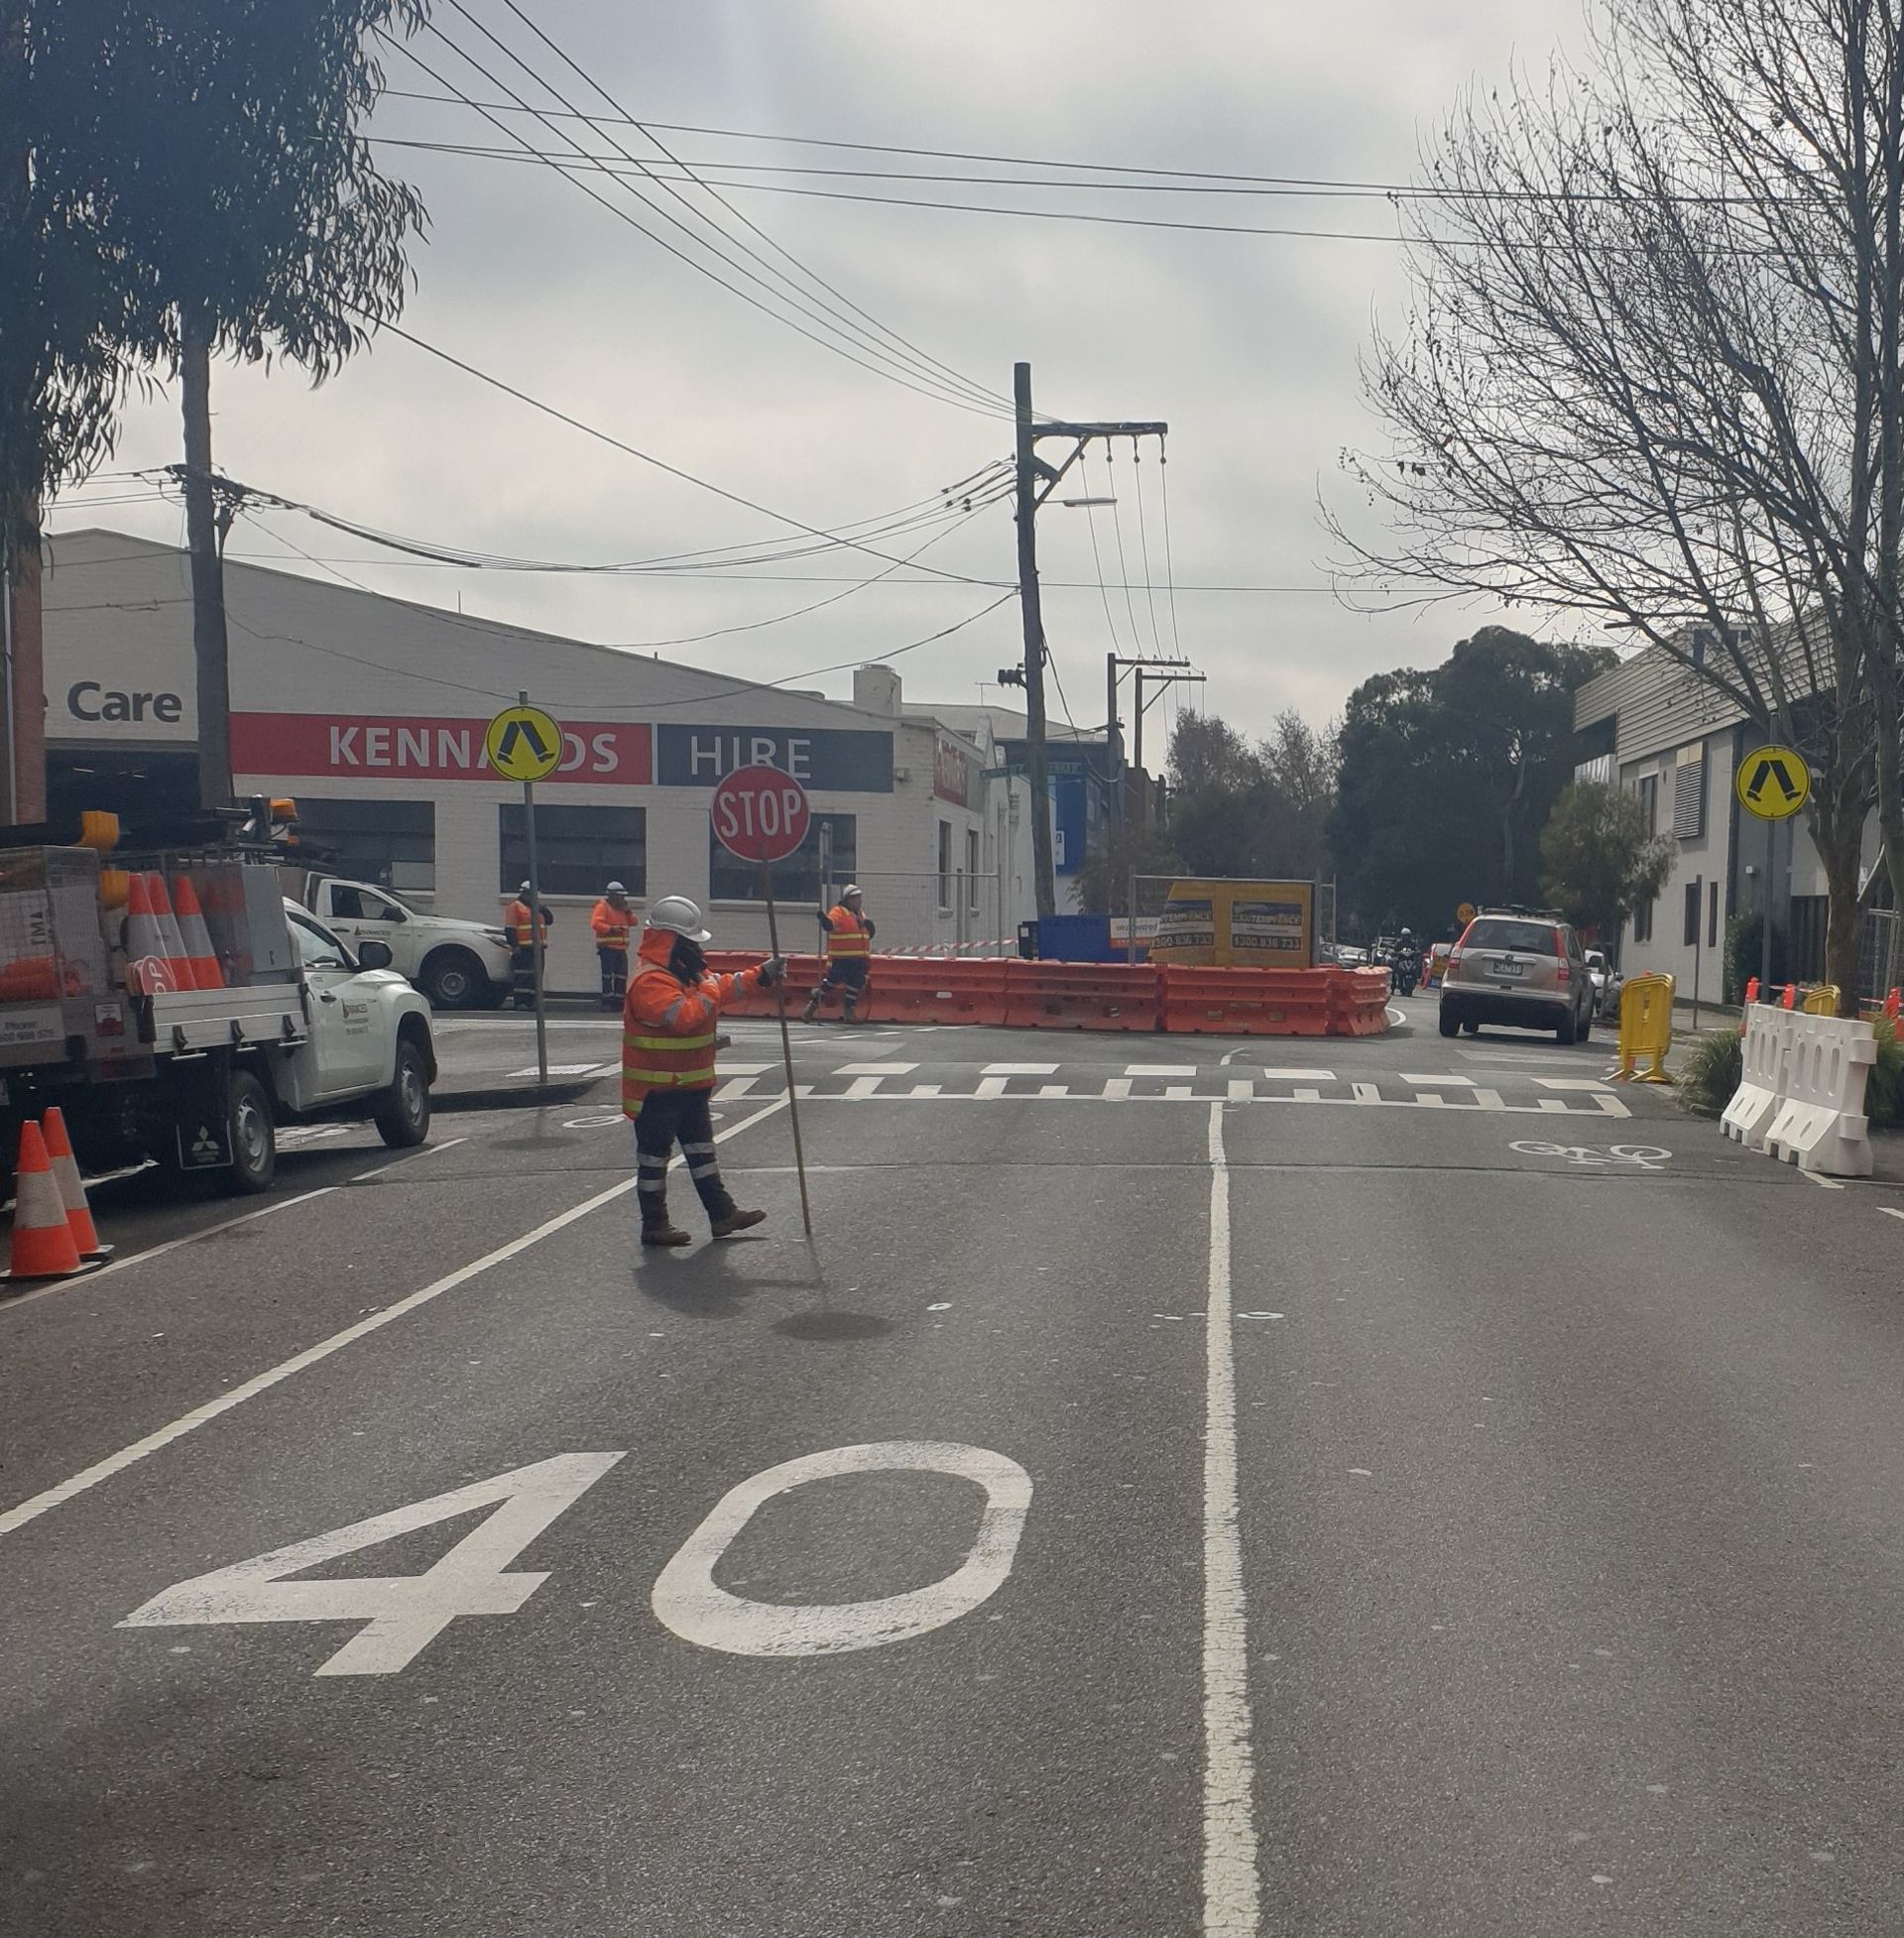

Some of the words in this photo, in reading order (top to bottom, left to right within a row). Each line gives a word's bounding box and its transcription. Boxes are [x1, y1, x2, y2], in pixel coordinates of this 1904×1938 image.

[67, 681, 182, 723] Care
[330, 726, 619, 773] KENNDS
[691, 736, 811, 779] HIRE
[719, 789, 801, 837] STOP
[113, 1441, 1033, 1676] 40
